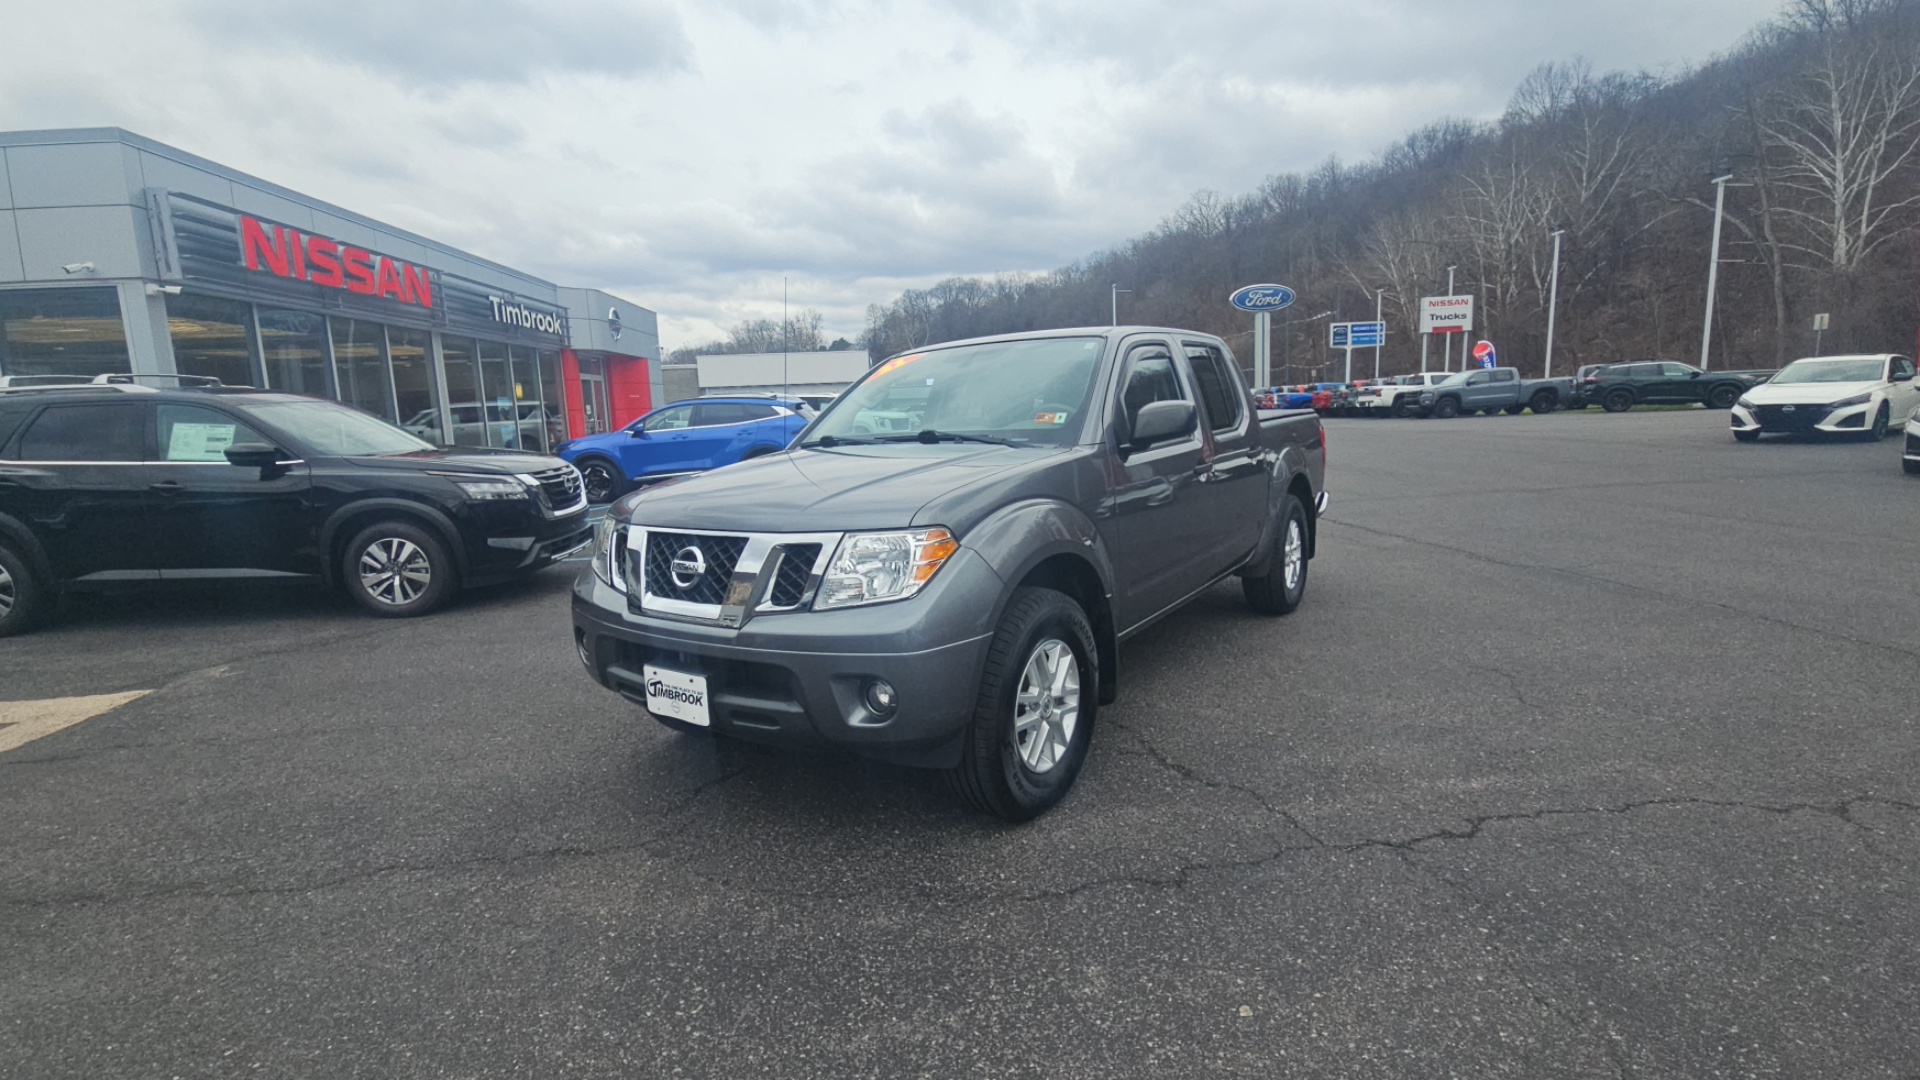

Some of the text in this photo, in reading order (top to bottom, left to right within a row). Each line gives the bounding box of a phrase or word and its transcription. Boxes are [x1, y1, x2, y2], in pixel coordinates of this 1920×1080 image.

[240, 215, 432, 308] NISSAN
[1245, 289, 1283, 307] Ford
[1428, 298, 1469, 308] NISSAN
[488, 295, 563, 335] Timbrook
[1429, 312, 1468, 321] Trucks
[647, 678, 704, 707] TIMBROOK
